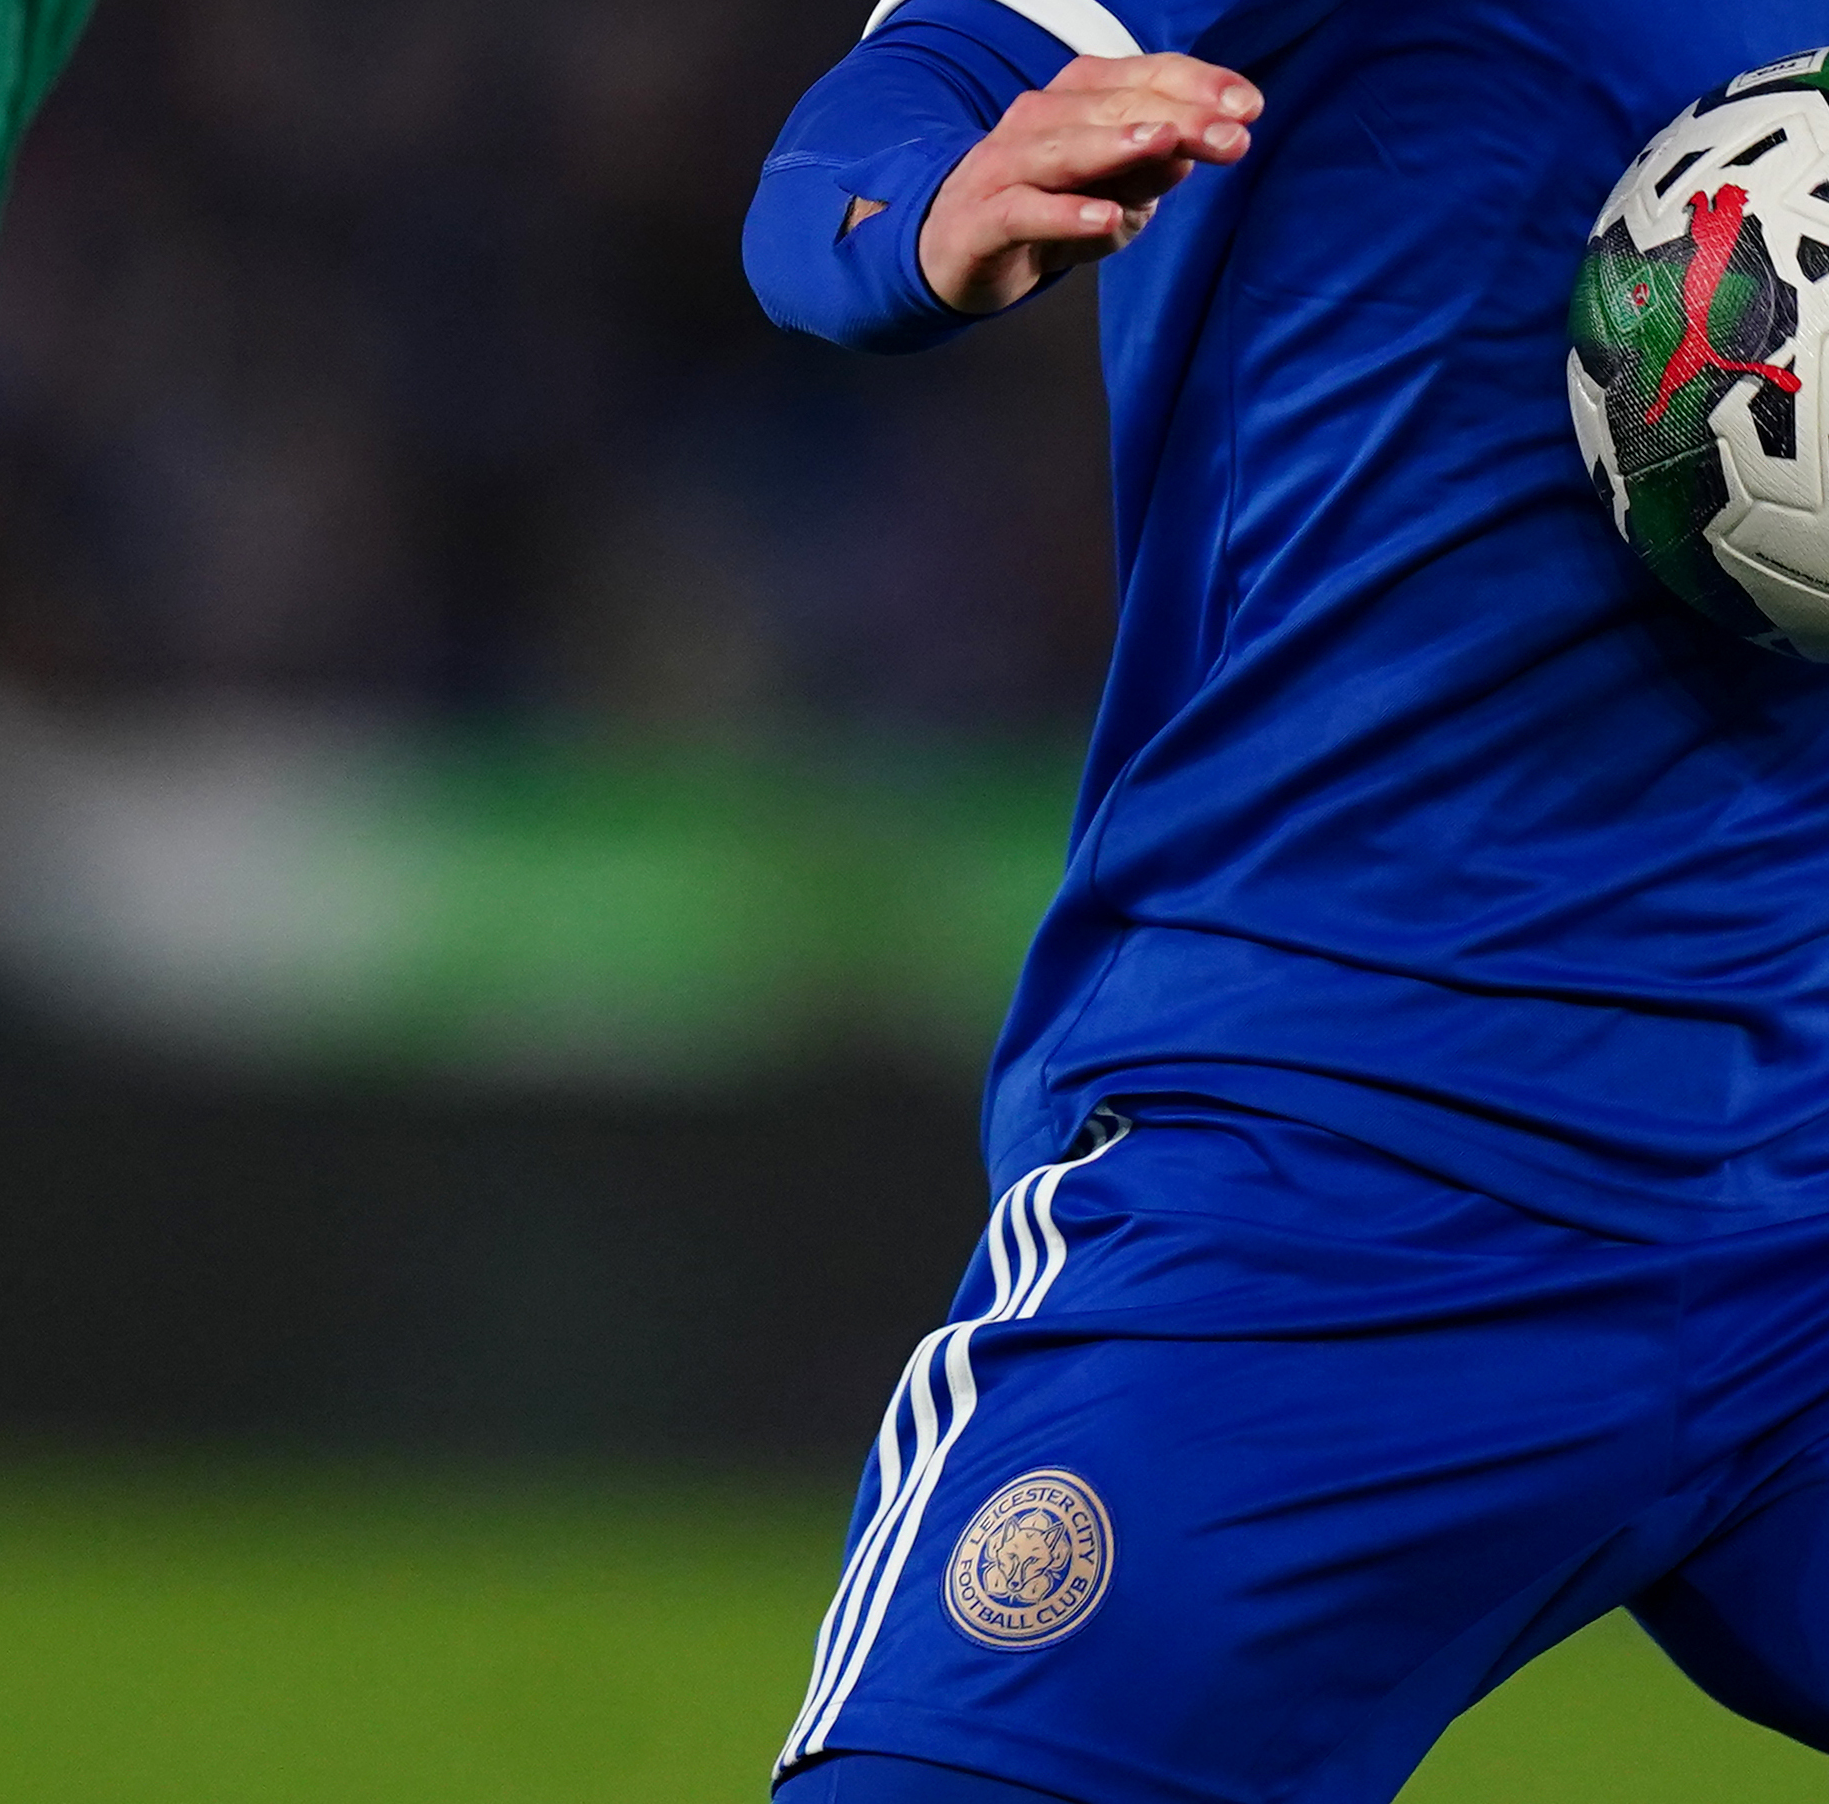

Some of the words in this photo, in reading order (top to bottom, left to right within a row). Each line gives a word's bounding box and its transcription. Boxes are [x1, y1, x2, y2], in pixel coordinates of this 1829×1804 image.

[969, 1487, 1075, 1547] LEICESTER
[1072, 1511, 1095, 1566] CITY
[958, 1558, 1033, 1630] FOOTBALL
[1036, 1577, 1089, 1625] CLUB
